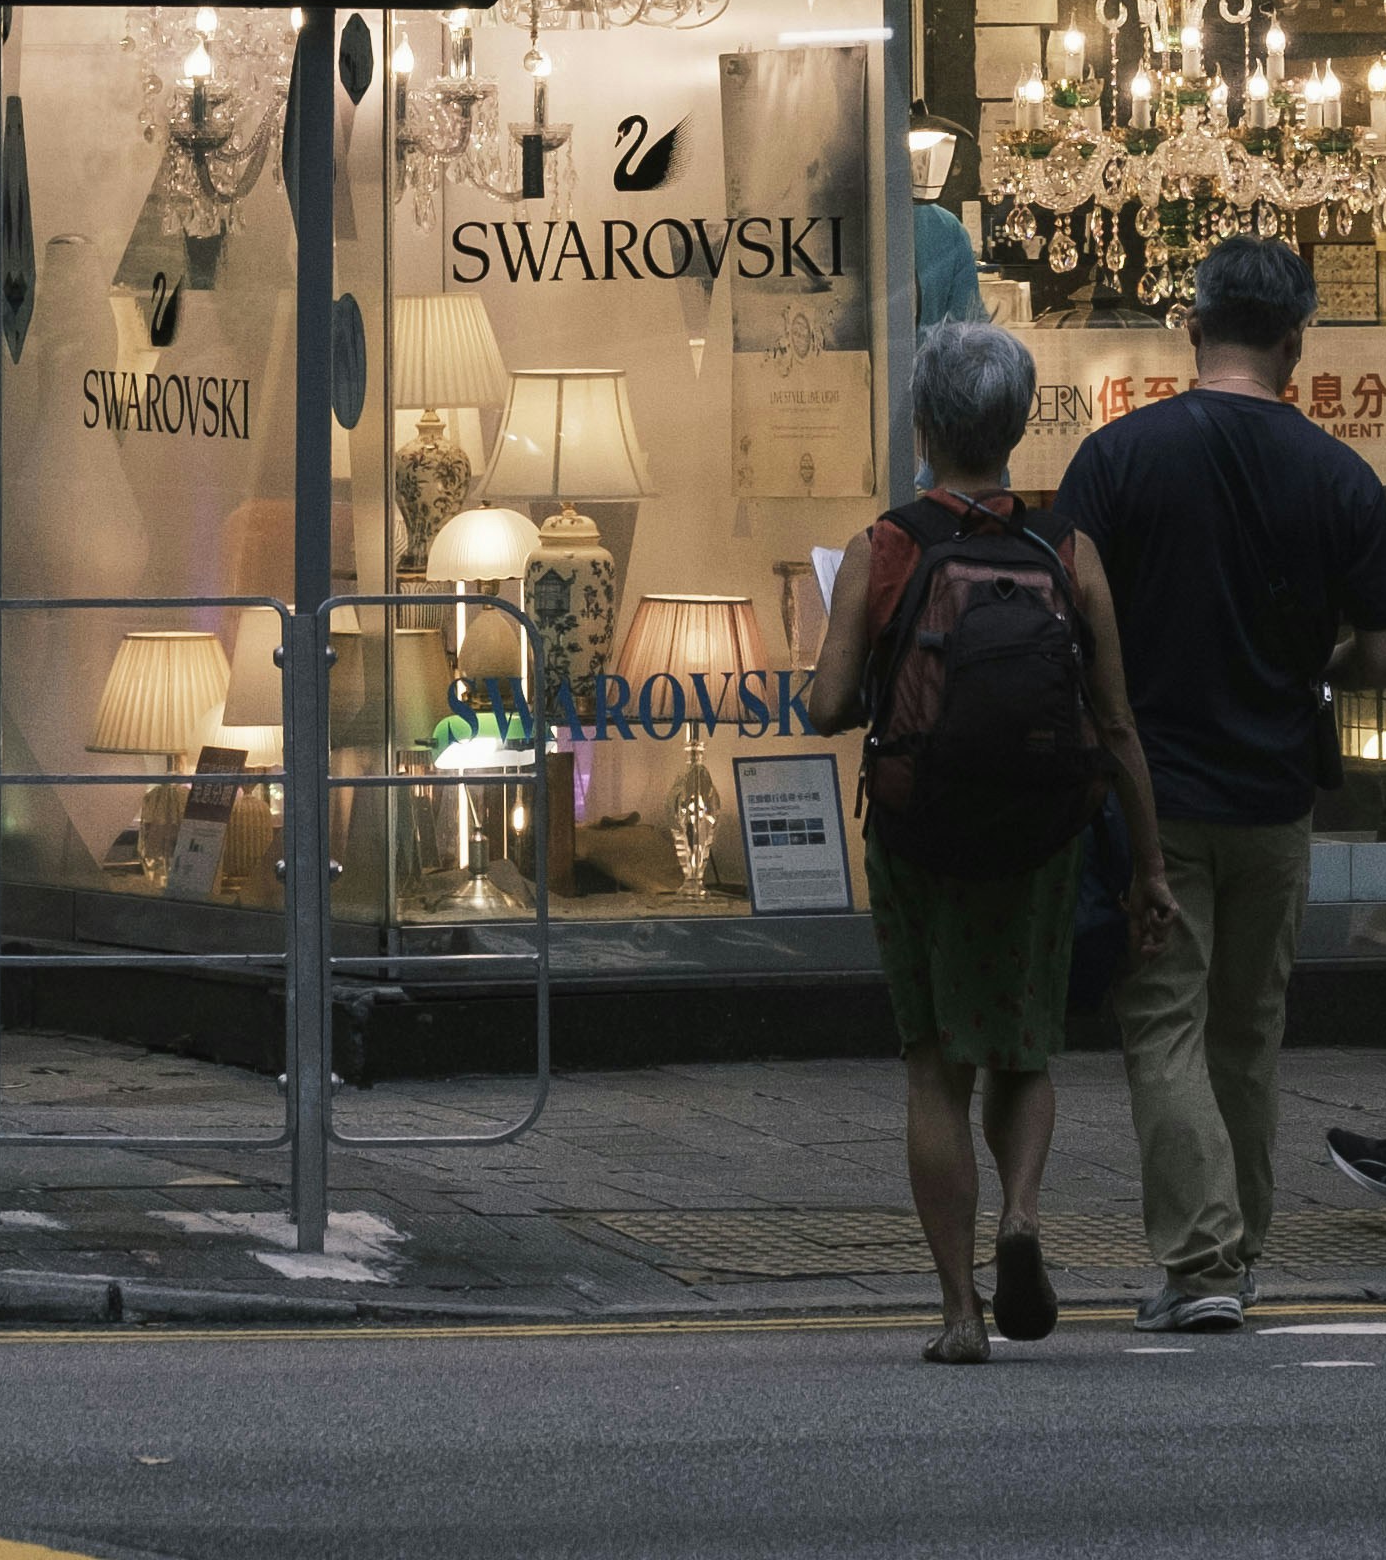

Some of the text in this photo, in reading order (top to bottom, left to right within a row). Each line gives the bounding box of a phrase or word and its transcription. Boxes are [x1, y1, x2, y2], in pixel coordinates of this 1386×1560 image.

[451, 215, 846, 285] SWAROVSKI
[82, 368, 251, 440] SWAROVSKI
[447, 669, 850, 746] SWAROVSK
